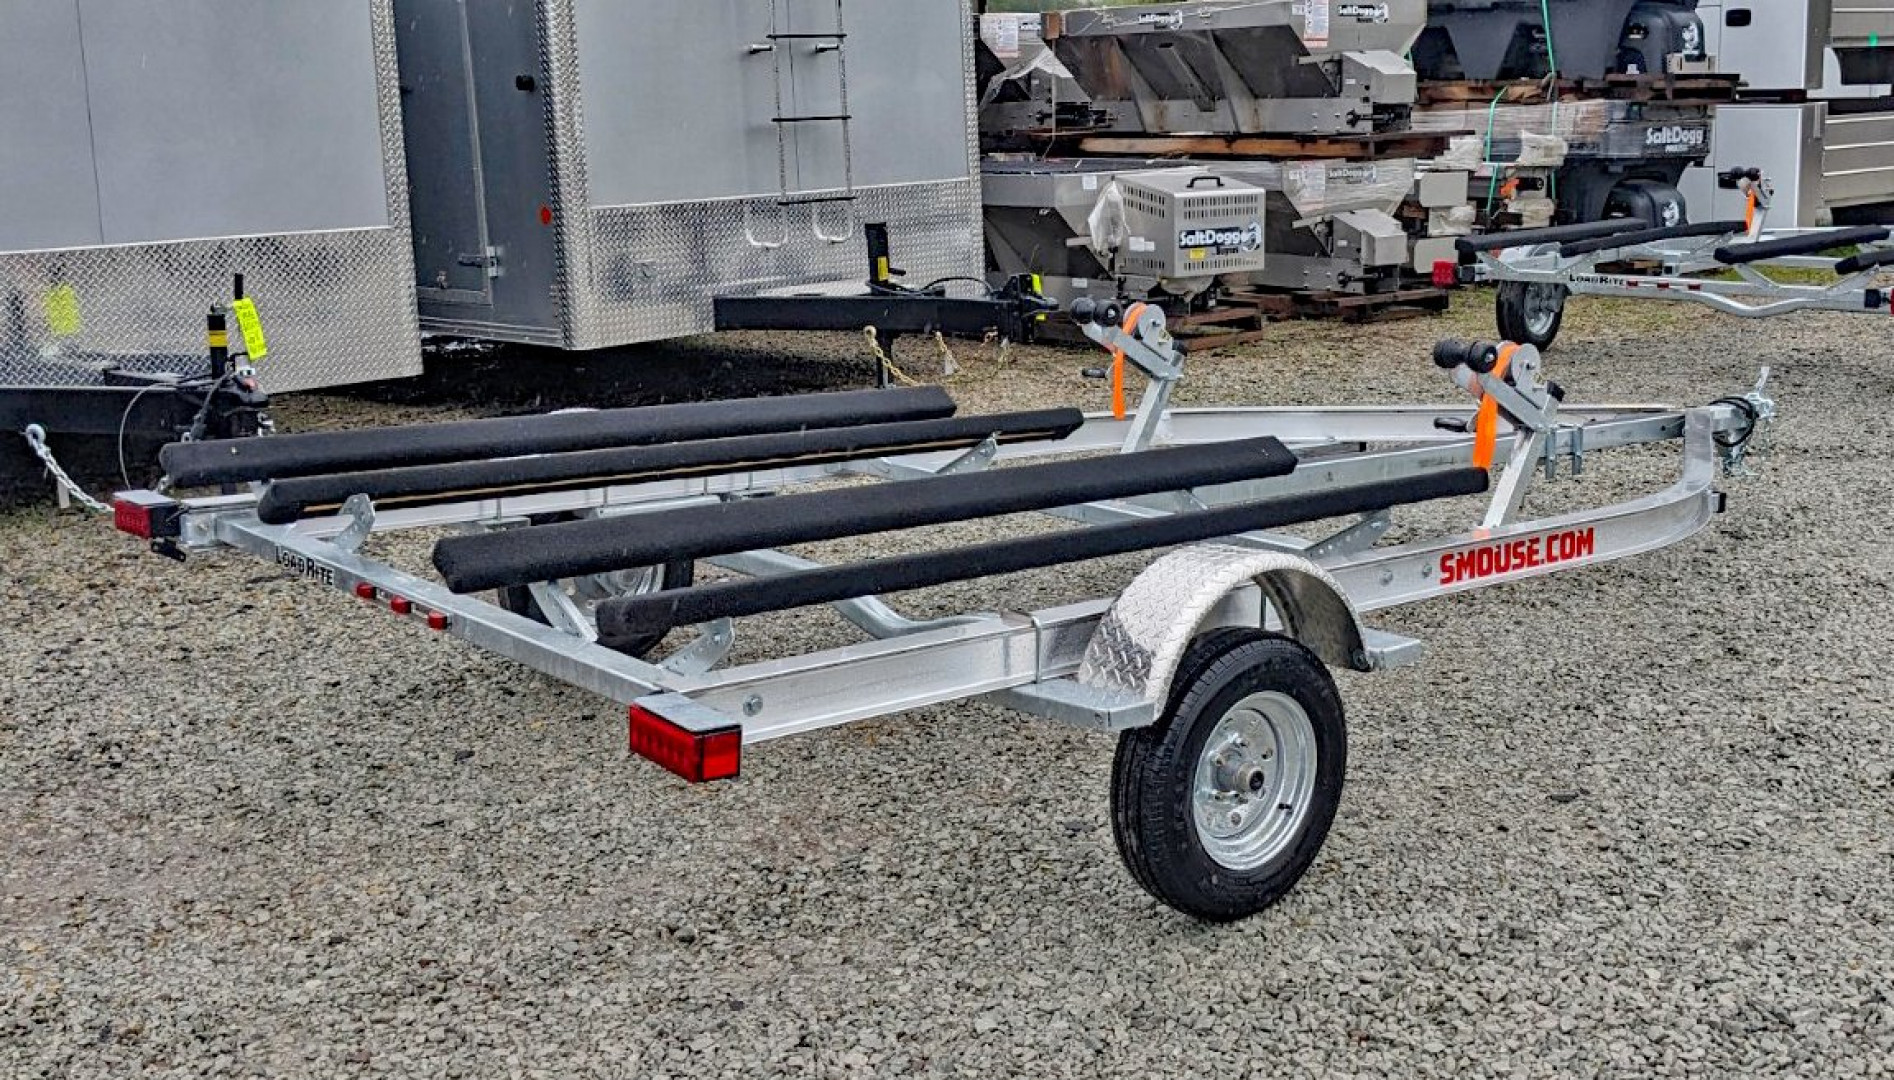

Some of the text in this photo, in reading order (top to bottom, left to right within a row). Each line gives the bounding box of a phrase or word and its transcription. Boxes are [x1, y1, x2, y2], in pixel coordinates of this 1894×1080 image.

[1645, 126, 1703, 145] SaltDogg
[1180, 230, 1241, 246] SaltDogg
[1440, 527, 1594, 585] SMOUSE.COM
